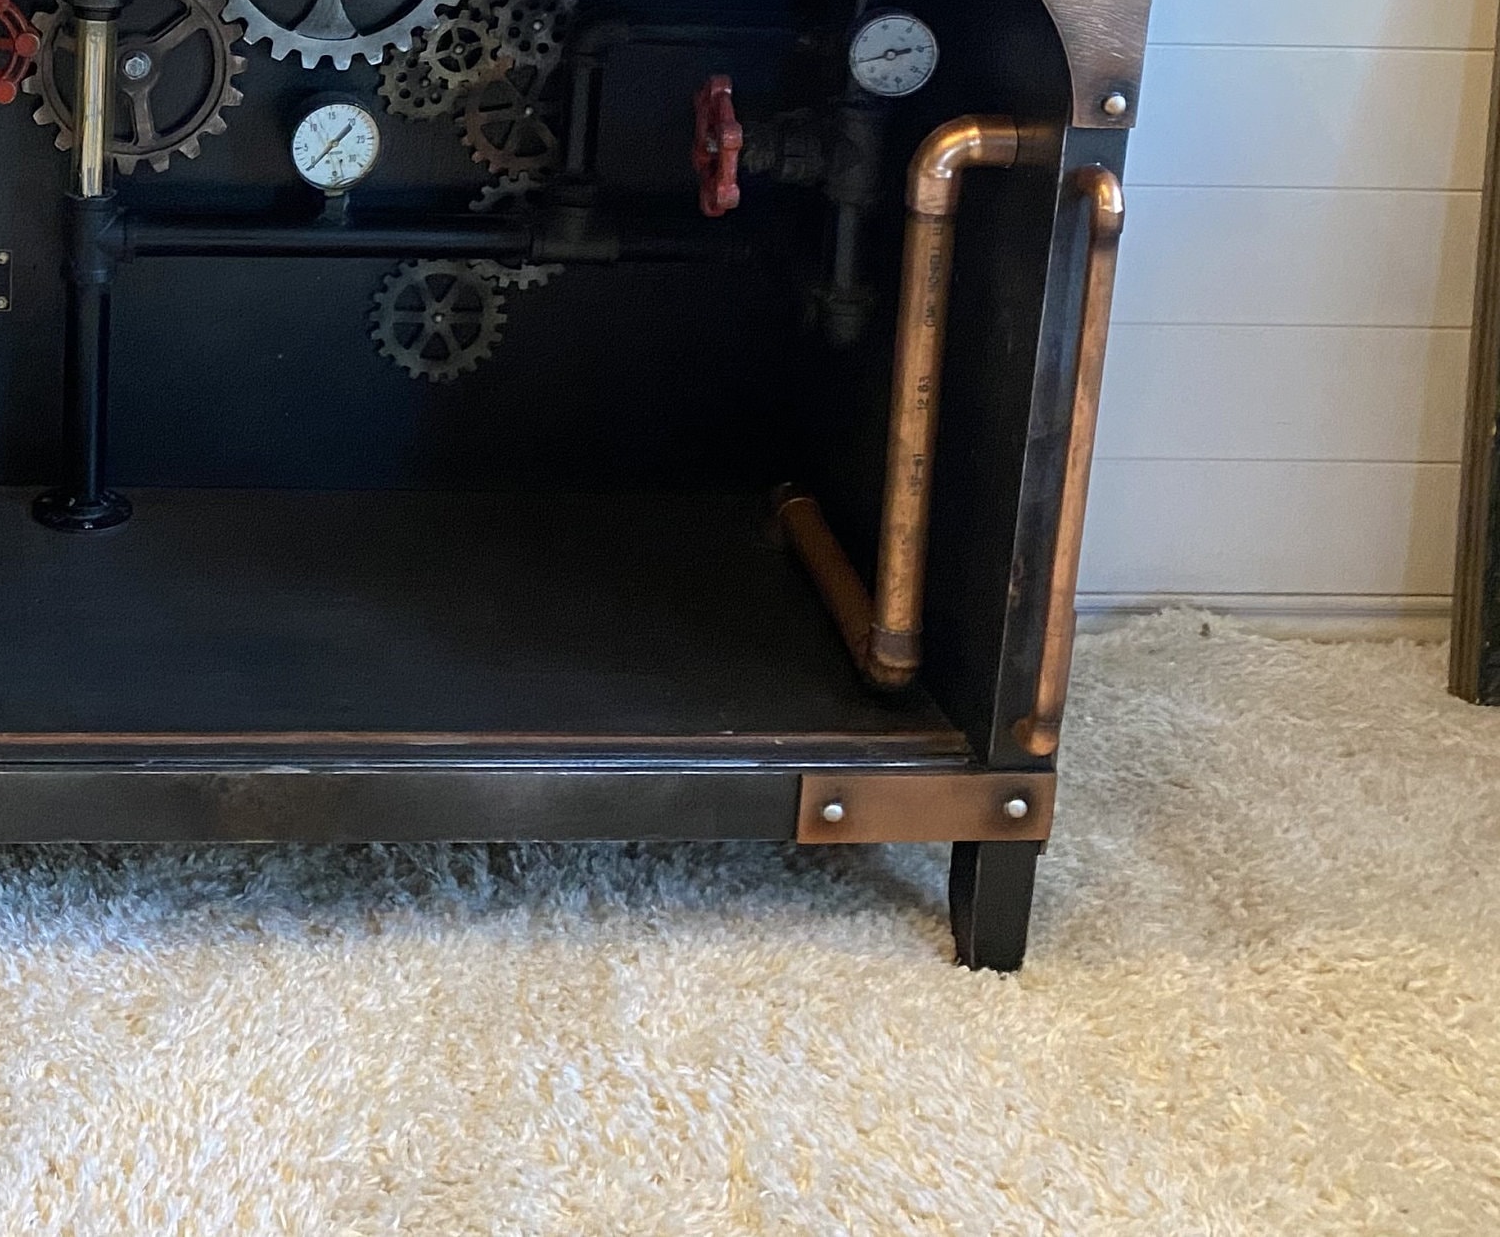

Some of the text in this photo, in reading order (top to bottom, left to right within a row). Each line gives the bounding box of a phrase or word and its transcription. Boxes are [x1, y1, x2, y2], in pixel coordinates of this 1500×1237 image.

[328, 112, 336, 120] 15
[356, 135, 366, 144] 25
[304, 143, 309, 152] 5
